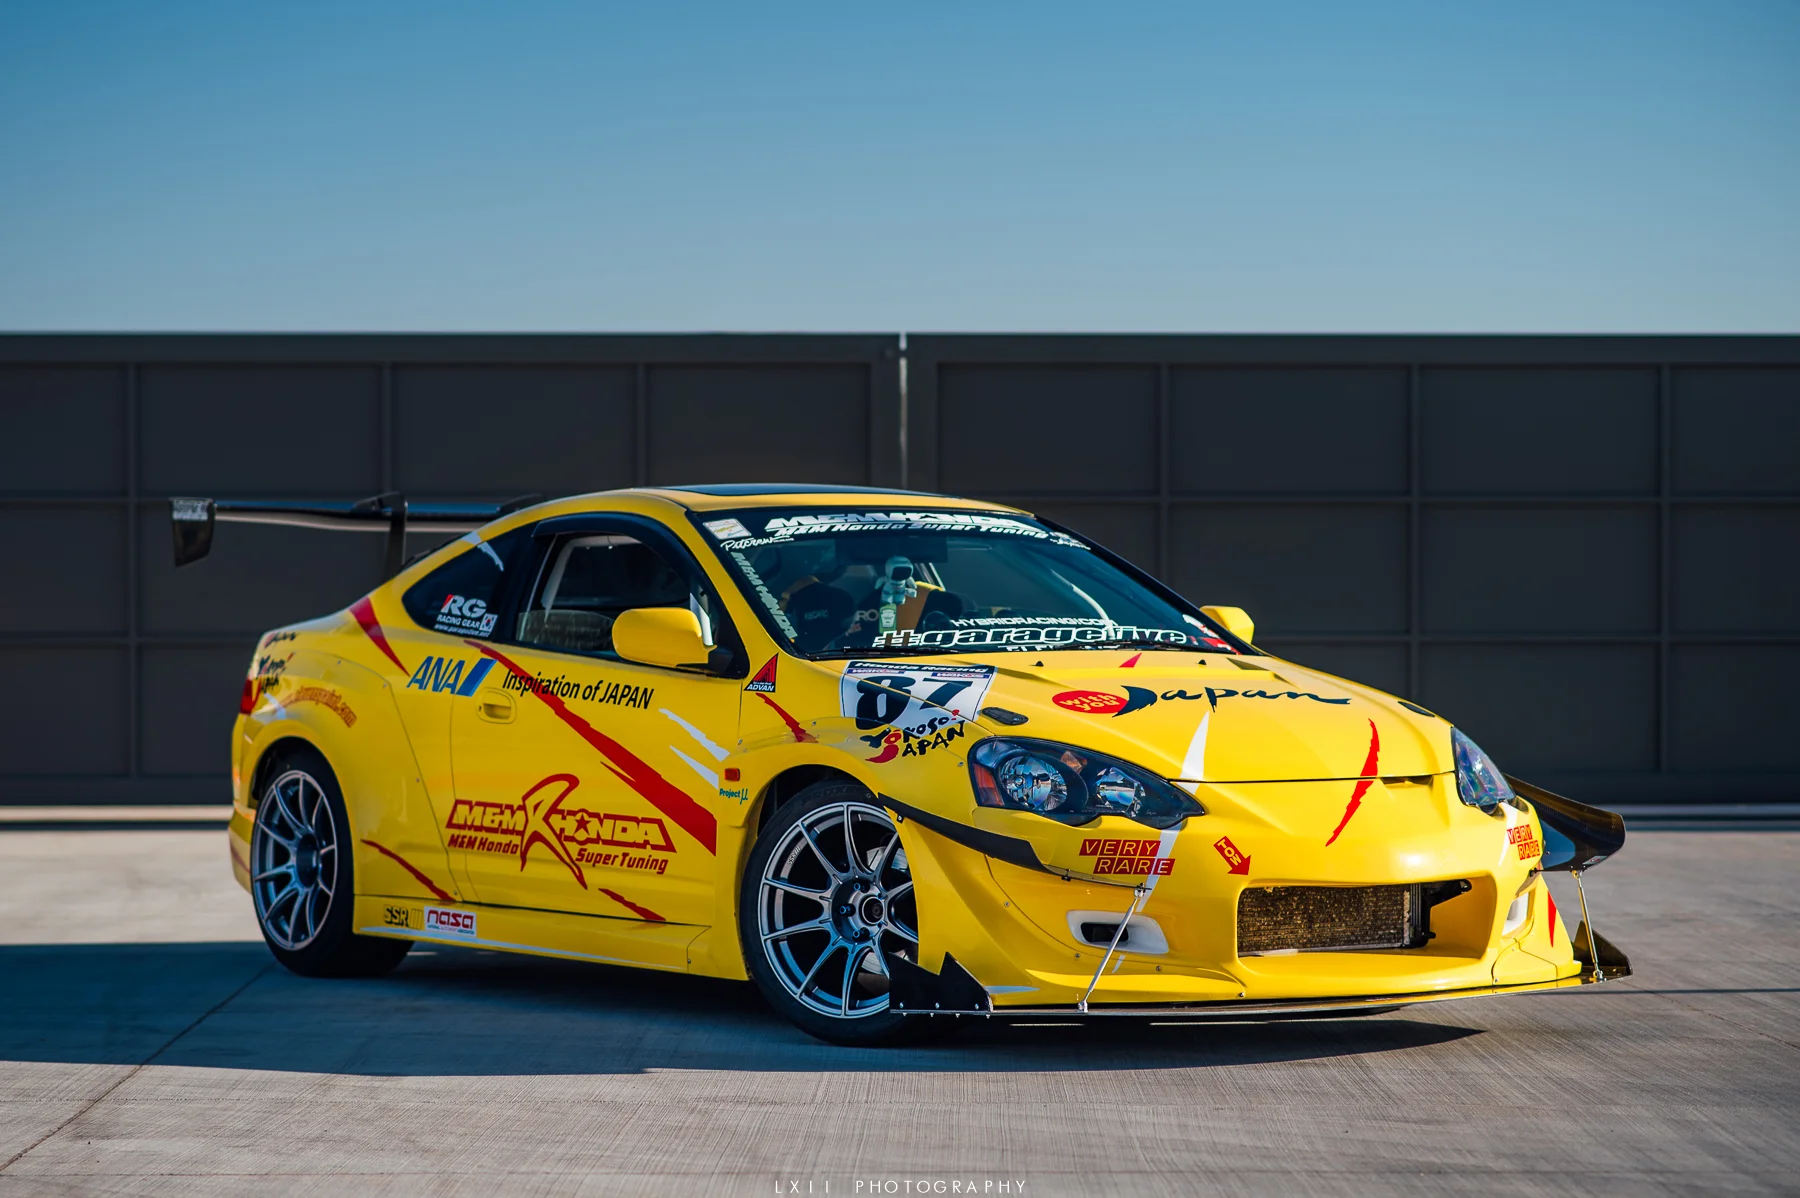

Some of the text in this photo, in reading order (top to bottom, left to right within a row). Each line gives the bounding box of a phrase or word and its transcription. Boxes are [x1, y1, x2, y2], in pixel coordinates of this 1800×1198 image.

[831, 521, 906, 532] Honda
[907, 522, 977, 531] Super
[978, 524, 1050, 539] Tuning
[441, 594, 488, 618] RG
[436, 614, 481, 629] RACING GEAR
[406, 656, 466, 695] ANA
[854, 662, 988, 673] Honda Racing
[502, 668, 655, 710] Inspiration of JAPAN
[746, 683, 775, 692] ADVAN
[855, 675, 974, 731] 87
[1059, 692, 1116, 708] with
[1076, 698, 1121, 712] you
[1111, 684, 1352, 719] Japan
[719, 787, 741, 799] Project
[449, 801, 527, 837] M&M
[447, 833, 520, 856] M&M Honda
[1507, 823, 1533, 845] VERY
[1082, 840, 1159, 857] VERY
[1217, 838, 1243, 866] TOW
[1517, 840, 1541, 861] RARE
[575, 847, 669, 875] Super Tuning
[1096, 858, 1173, 875] RARE
